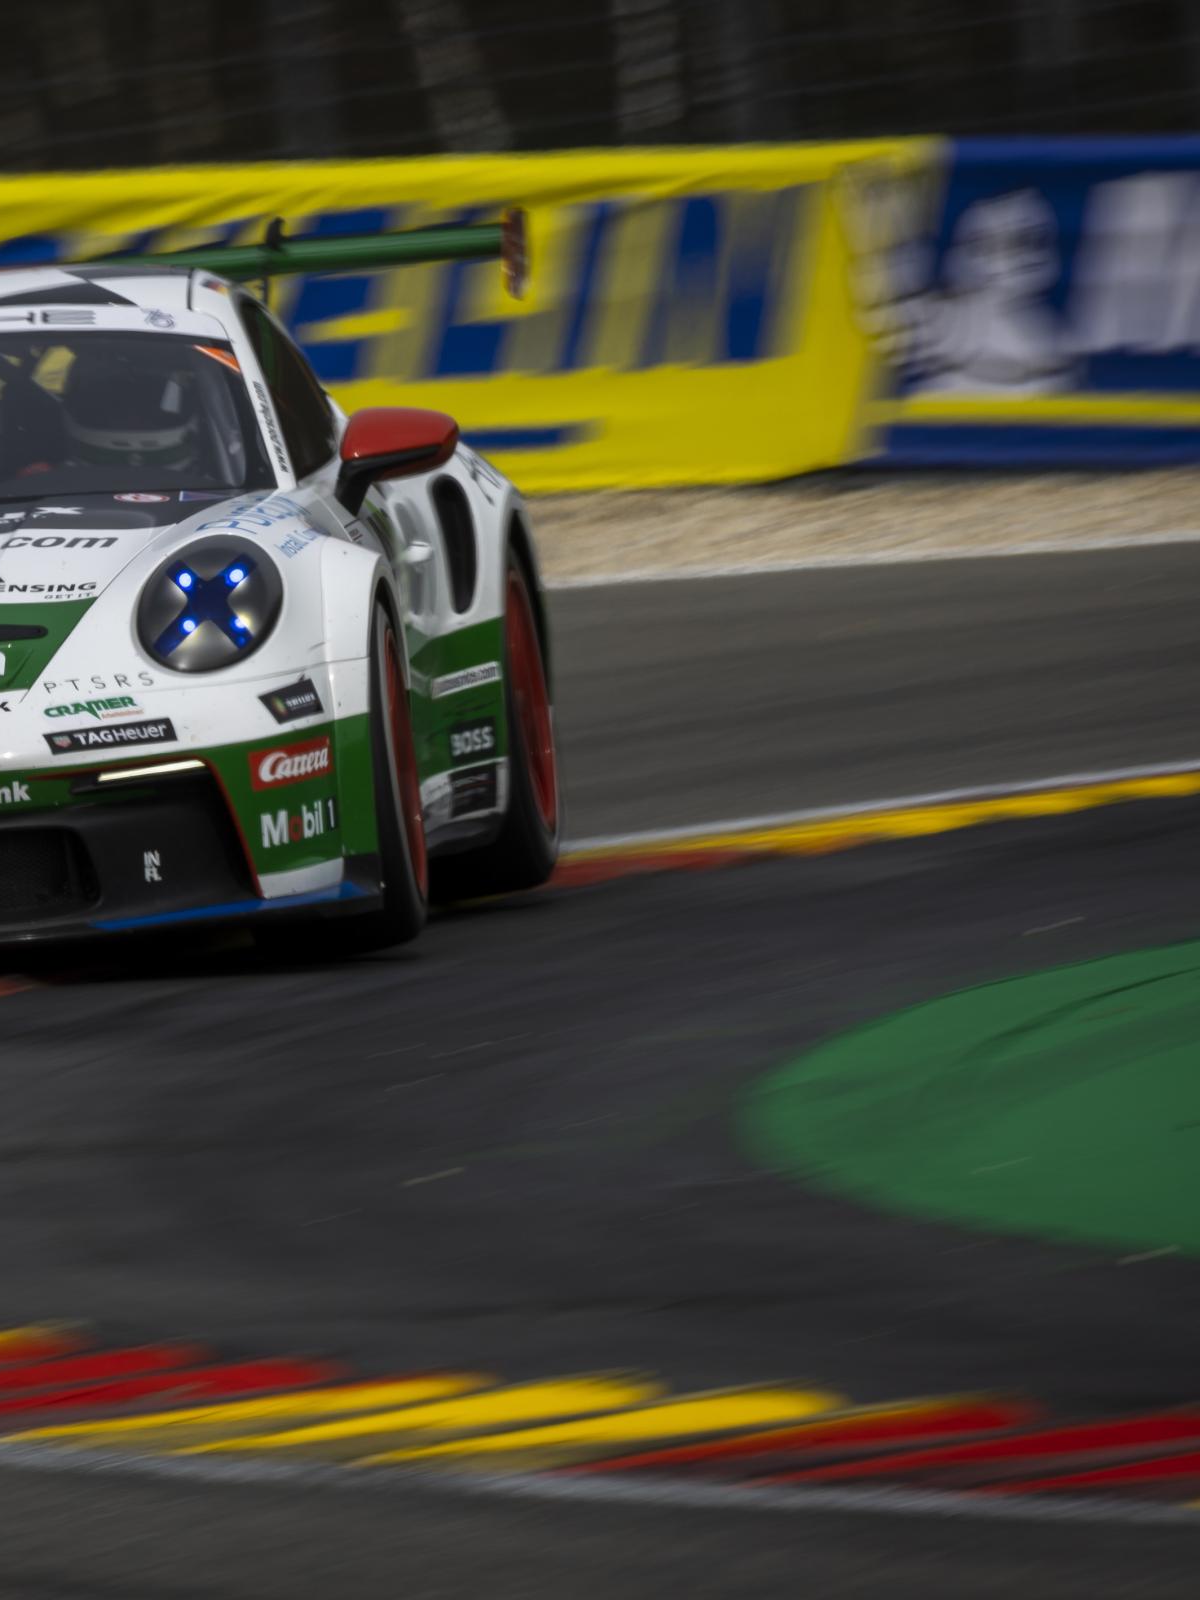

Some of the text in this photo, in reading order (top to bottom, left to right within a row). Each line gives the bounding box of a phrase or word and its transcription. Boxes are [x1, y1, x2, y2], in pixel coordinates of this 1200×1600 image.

[44, 695, 138, 720] CRAMER
[450, 725, 496, 757] BOSS
[257, 747, 331, 783] Carrera
[260, 798, 336, 849] Mobil 1
